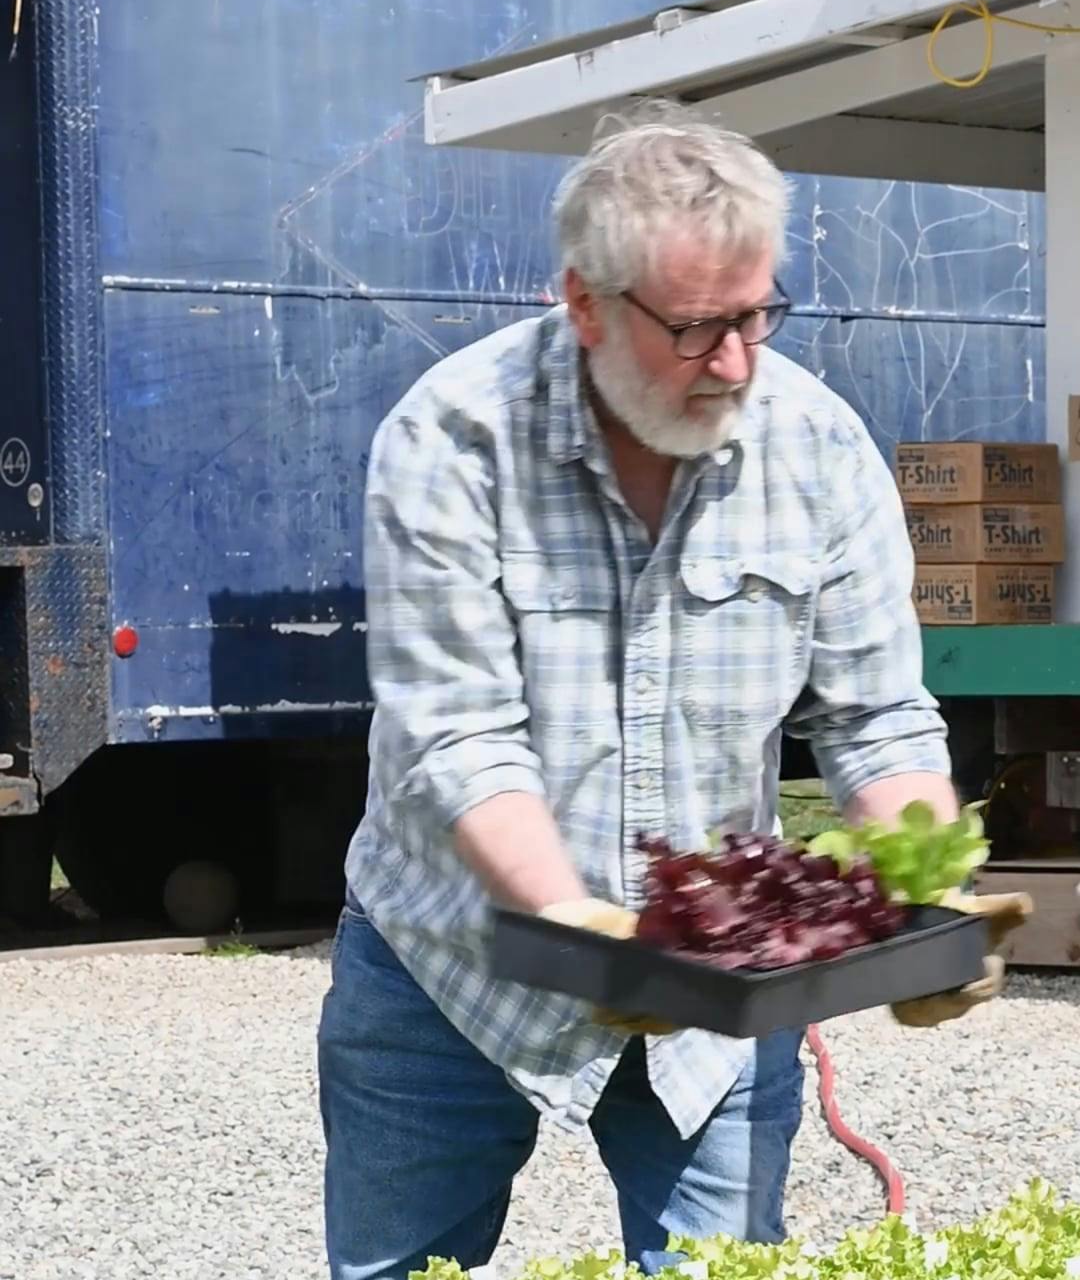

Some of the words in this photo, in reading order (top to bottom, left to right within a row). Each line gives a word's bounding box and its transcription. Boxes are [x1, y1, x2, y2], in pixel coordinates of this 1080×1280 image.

[4, 451, 26, 474] 44
[984, 463, 1034, 482] T-Shirt
[898, 464, 956, 485] T-Shirt
[984, 524, 1041, 544] T-Shirt
[916, 584, 972, 605] T-Shirt
[998, 583, 1051, 604] T-Shirt
